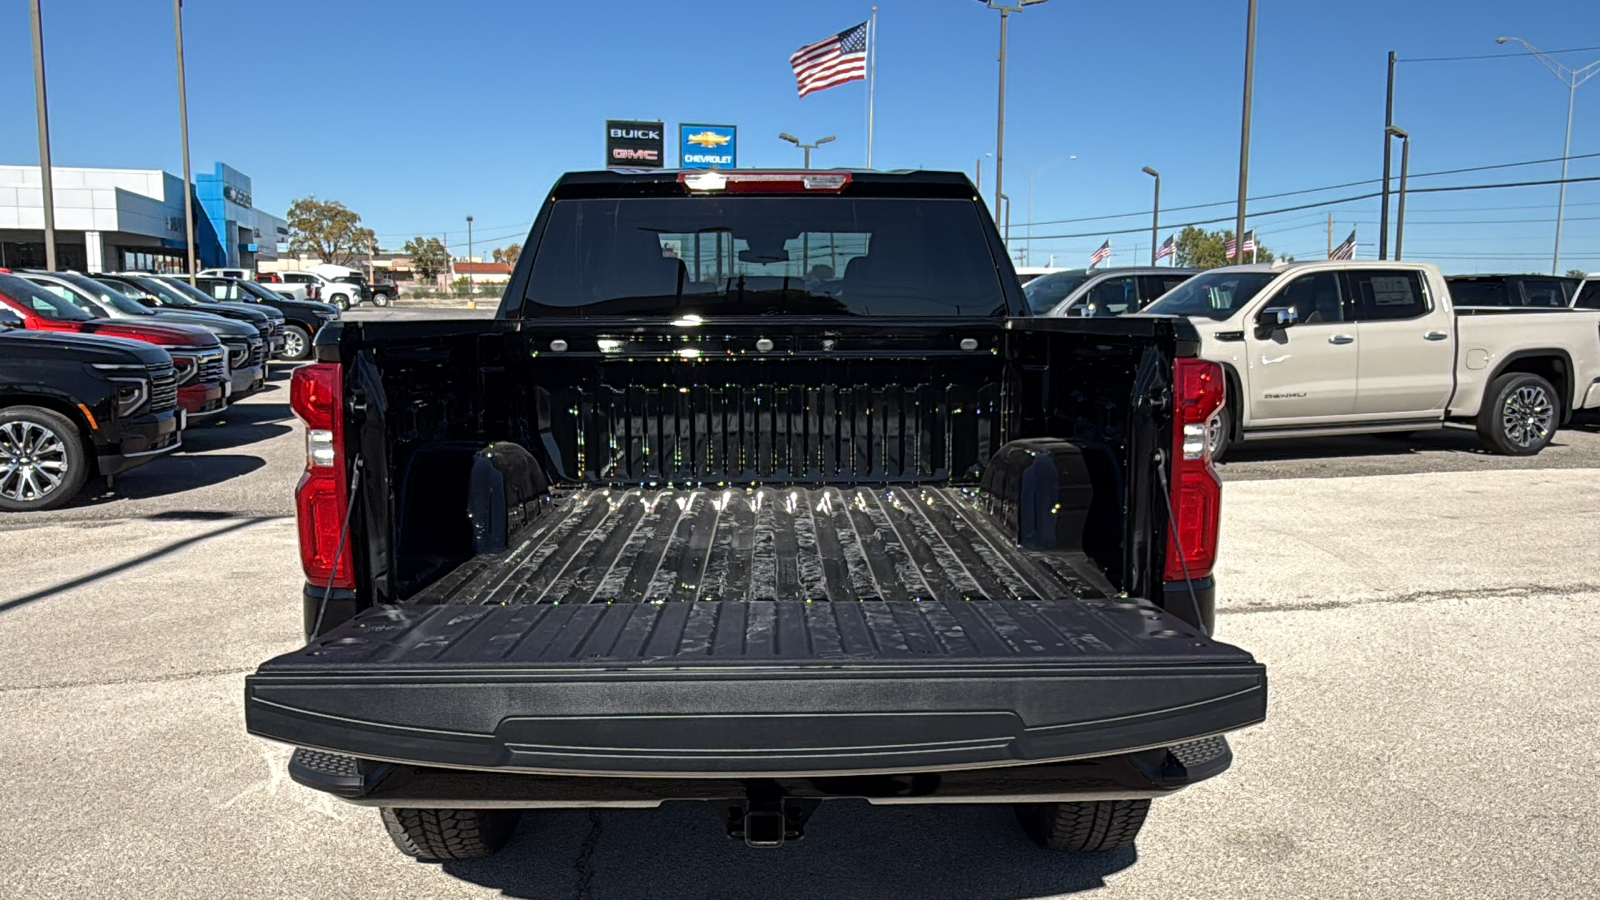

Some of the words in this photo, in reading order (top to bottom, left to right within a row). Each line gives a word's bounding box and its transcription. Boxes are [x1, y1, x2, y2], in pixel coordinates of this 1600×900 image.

[610, 129, 660, 139] BUICK
[613, 149, 658, 160] GMC
[684, 154, 732, 163] CHEVROLET
